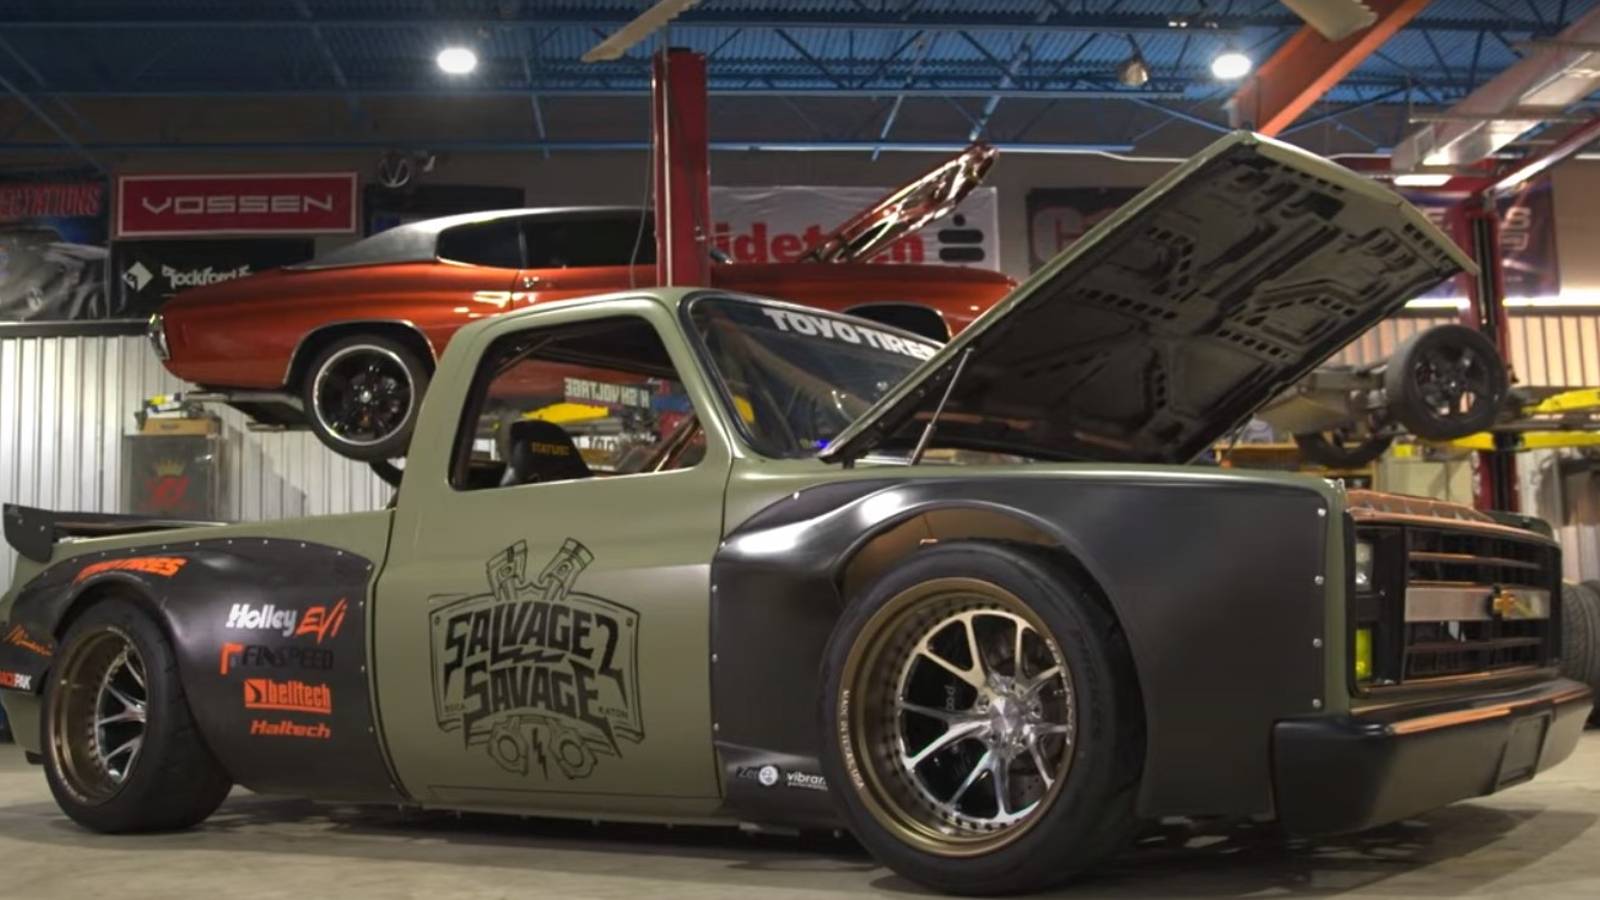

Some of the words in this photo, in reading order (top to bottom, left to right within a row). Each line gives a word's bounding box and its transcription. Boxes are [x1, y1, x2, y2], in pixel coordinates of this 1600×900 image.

[142, 195, 333, 214] VOSSEN
[762, 307, 860, 343] TOYO
[858, 327, 939, 361] TIRES
[225, 603, 299, 637] Holley
[444, 601, 595, 698] SALVAGE
[594, 613, 629, 708] 2
[267, 679, 331, 708] belltech
[462, 658, 623, 757] SAVAGE
[250, 720, 332, 738] Haltech
